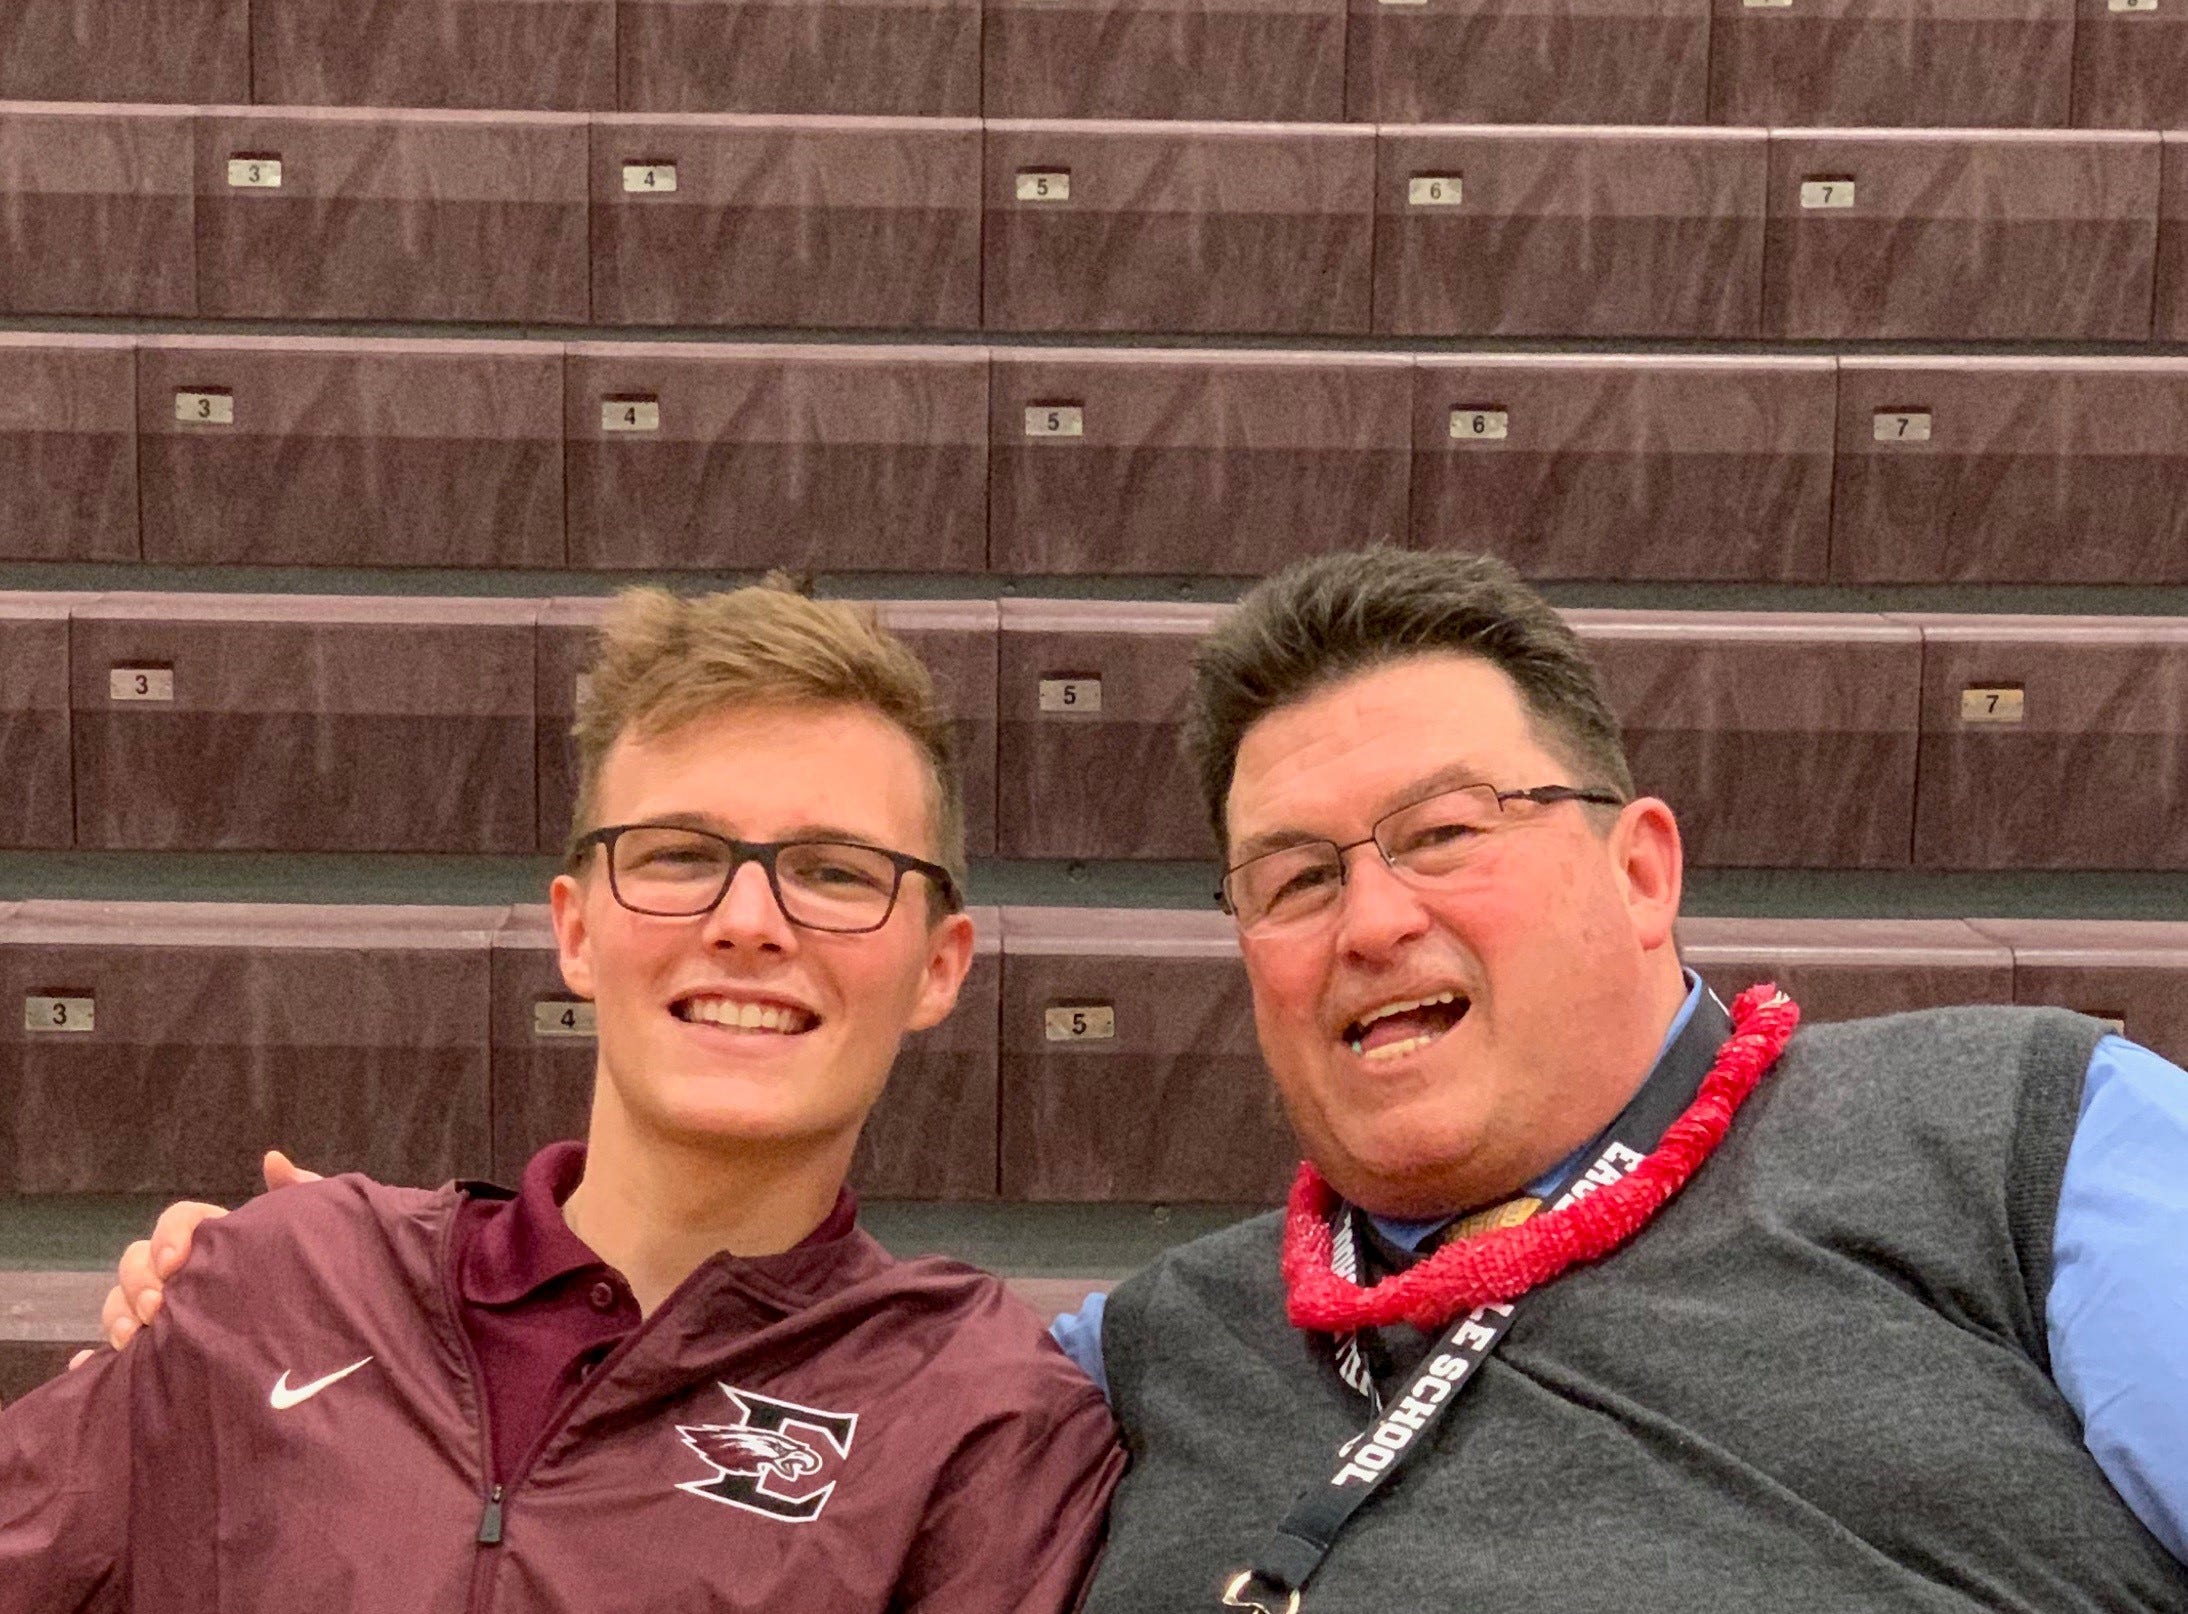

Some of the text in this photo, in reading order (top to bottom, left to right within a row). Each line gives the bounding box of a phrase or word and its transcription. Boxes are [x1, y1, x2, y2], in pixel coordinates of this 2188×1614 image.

[248, 164, 261, 183] 3
[643, 170, 656, 187] 4
[1037, 177, 1049, 196] 5
[1429, 182, 1442, 200] 6
[1822, 186, 1834, 204] 7
[198, 398, 211, 419] 3
[623, 406, 636, 425] 4
[1047, 411, 1060, 432] 5
[1472, 414, 1485, 434] 6
[1897, 417, 1909, 437] 7
[135, 674, 149, 695] 3
[1063, 685, 1077, 705] 5
[1986, 694, 1999, 714] 7
[52, 1002, 67, 1026] 3
[560, 1008, 576, 1029] 4
[1071, 1013, 1087, 1036] 5
[1331, 1354, 1469, 1486] SCHOOL
